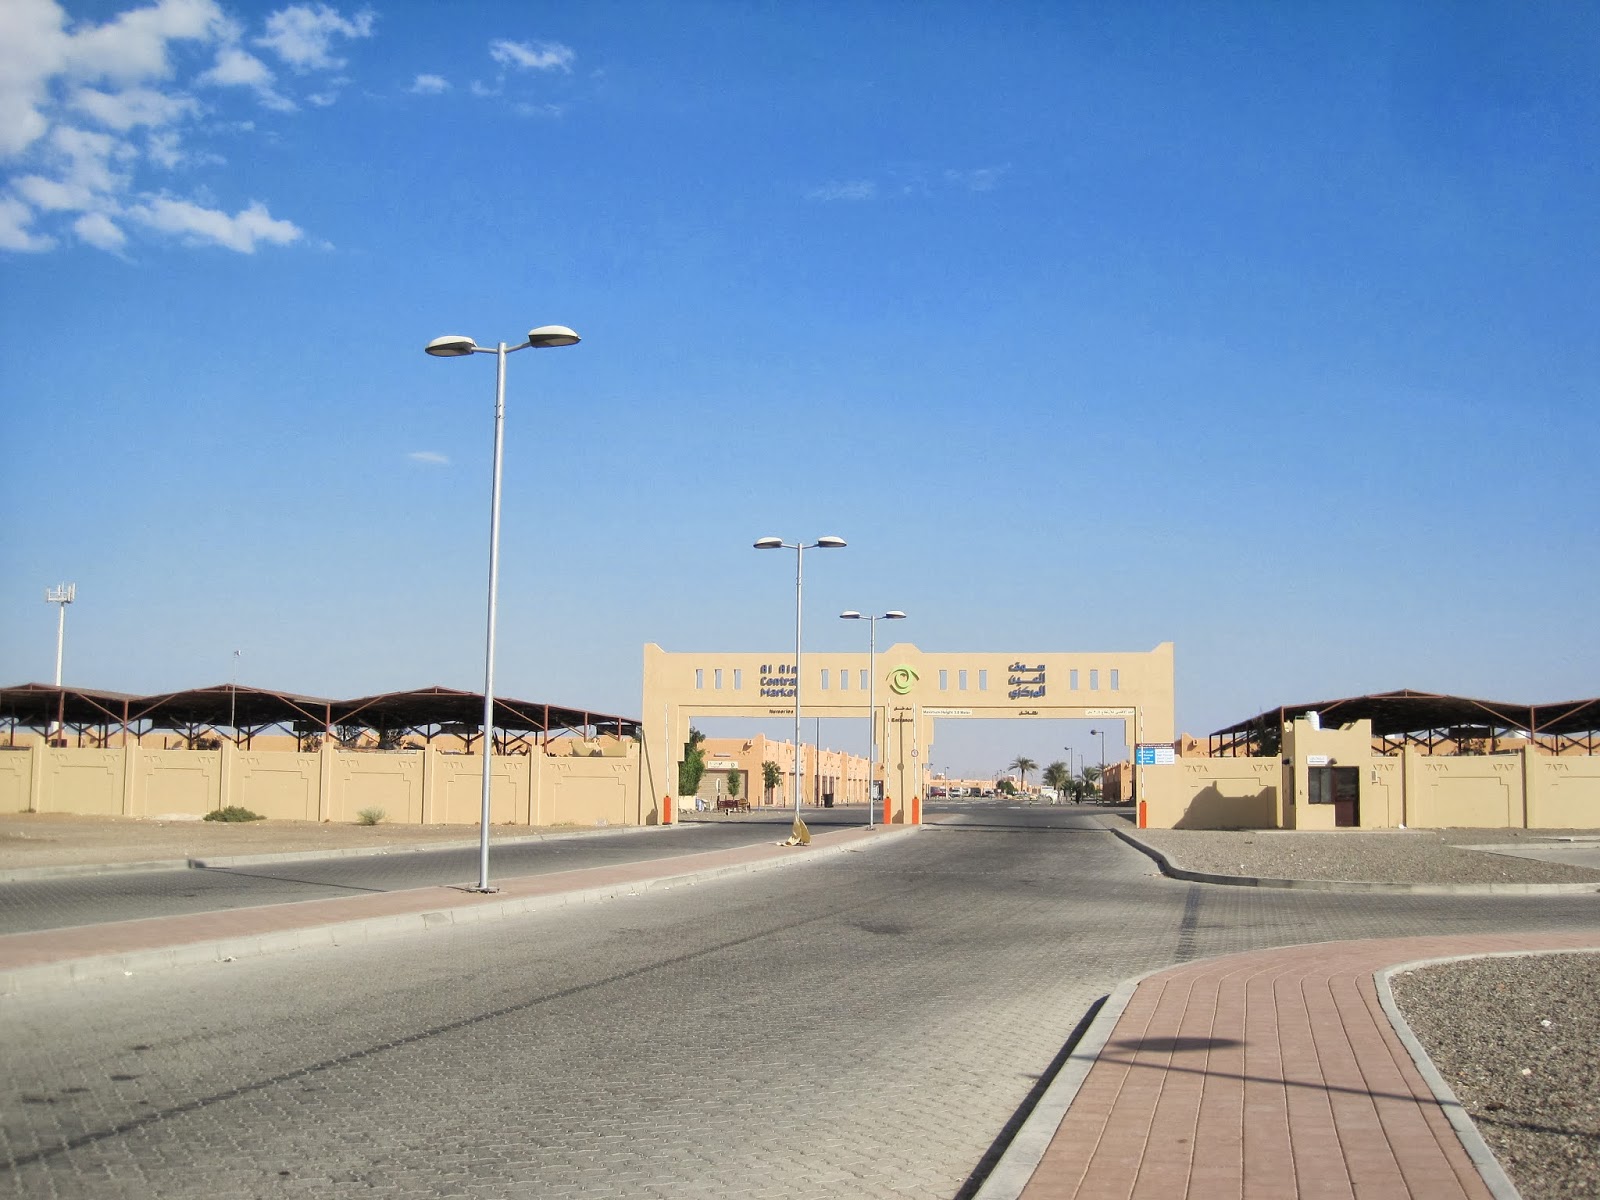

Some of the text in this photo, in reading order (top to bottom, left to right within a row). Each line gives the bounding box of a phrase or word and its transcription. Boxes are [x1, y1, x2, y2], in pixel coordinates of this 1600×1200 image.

[760, 664, 772, 674] Al
[1008, 661, 1046, 673] سوق
[760, 676, 797, 686] Centra
[1008, 672, 1046, 687] العين
[1008, 685, 1046, 700] المركزي
